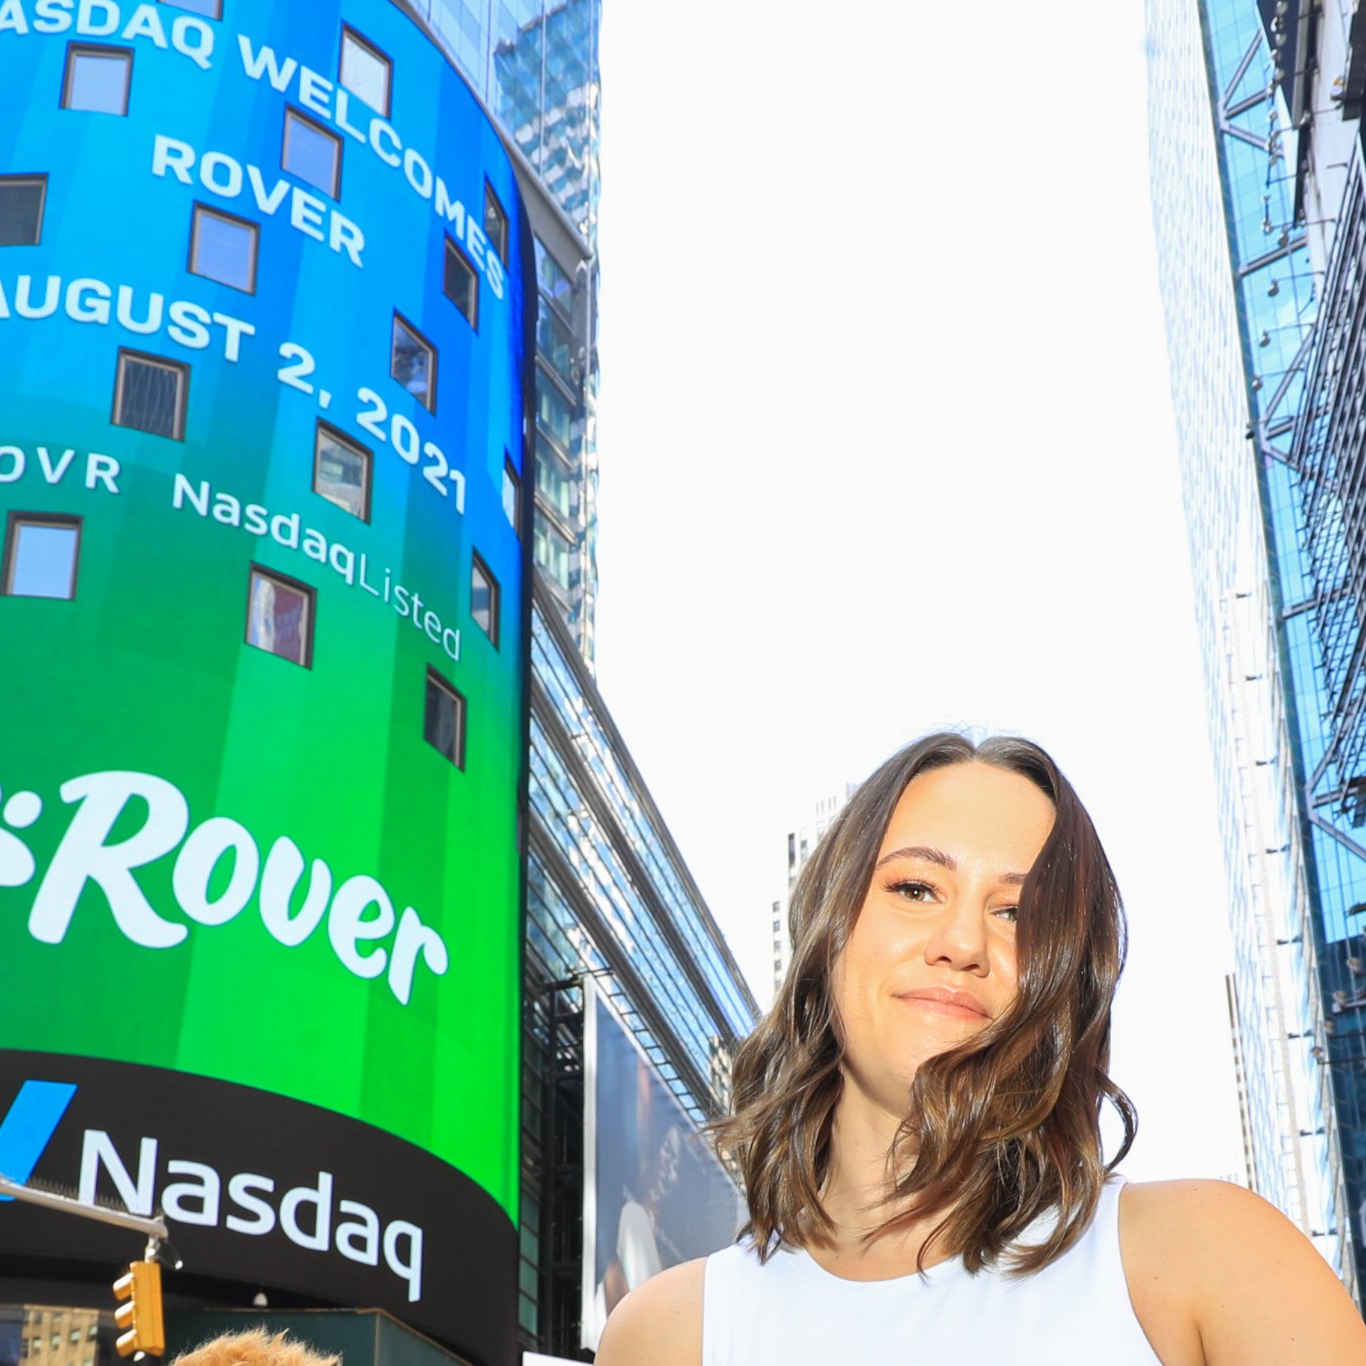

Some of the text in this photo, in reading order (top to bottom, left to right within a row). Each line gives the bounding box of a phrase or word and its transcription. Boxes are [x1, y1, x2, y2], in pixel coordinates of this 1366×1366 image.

[151, 135, 366, 268] ROVER
[237, 34, 504, 299] WELCOMES
[278, 342, 332, 409] 2,
[357, 388, 468, 515] 2021
[28, 771, 448, 1005] Rover
[77, 1128, 423, 1303] Nasdaq
